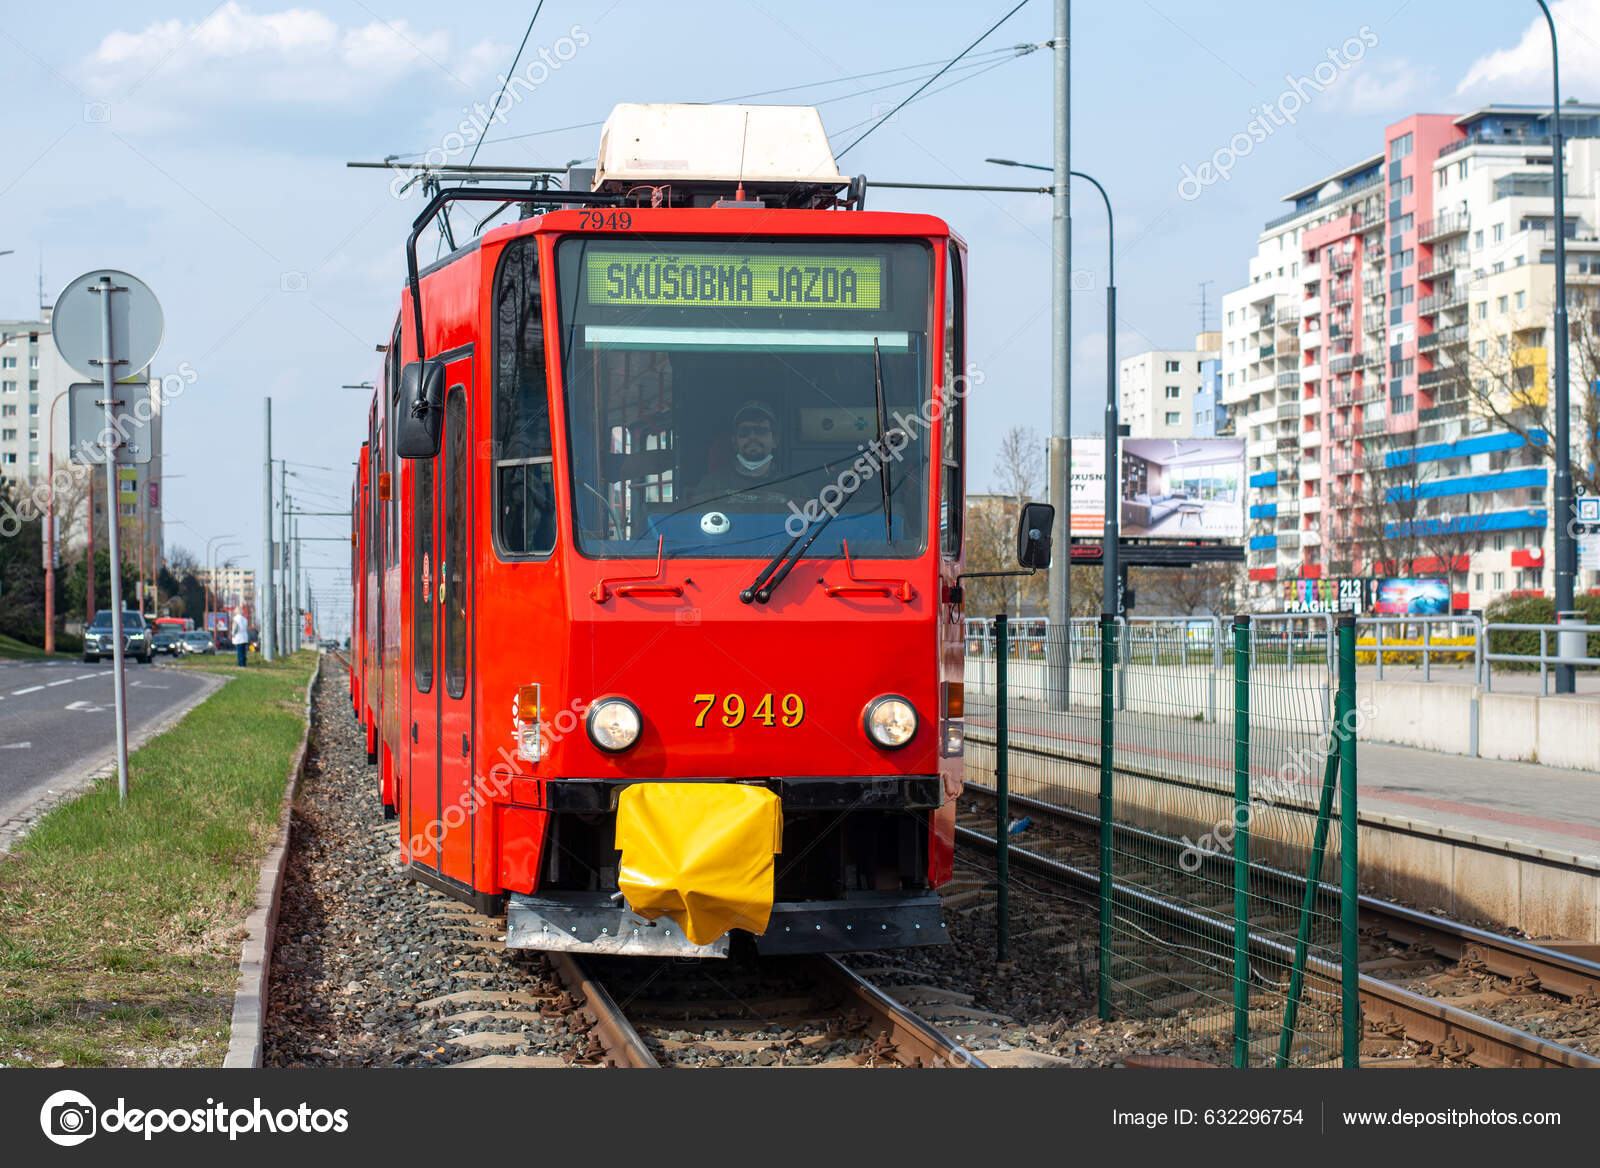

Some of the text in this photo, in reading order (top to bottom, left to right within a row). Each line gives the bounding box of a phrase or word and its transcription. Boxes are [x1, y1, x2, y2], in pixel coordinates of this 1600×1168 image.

[579, 211, 632, 230] 7949
[606, 256, 857, 303] SKÚŠOBNÁ JAZDA
[1340, 579, 1361, 598] 21.3
[1284, 600, 1339, 613] FRAGILE
[693, 693, 806, 729] 7949
